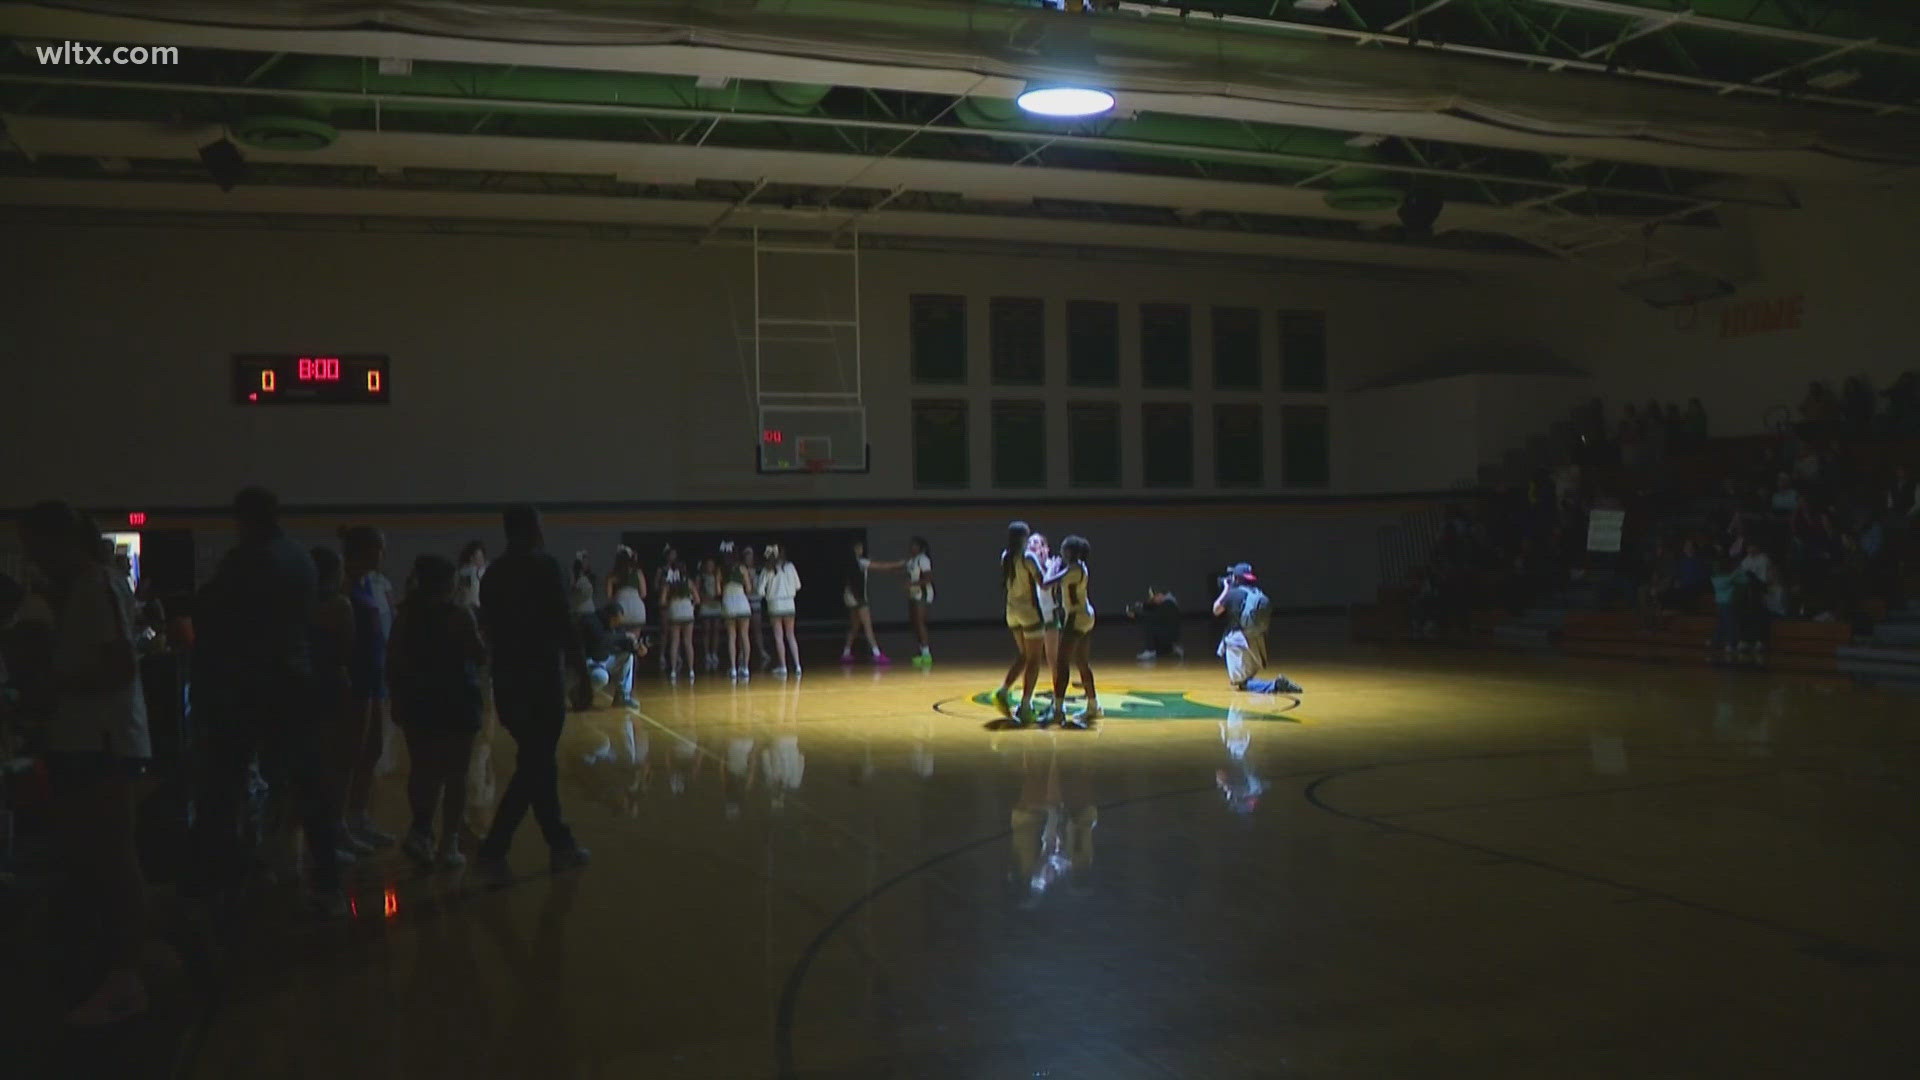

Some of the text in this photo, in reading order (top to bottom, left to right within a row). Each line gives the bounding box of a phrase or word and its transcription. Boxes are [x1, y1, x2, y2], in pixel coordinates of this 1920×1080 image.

[261, 369, 275, 392] 0
[299, 358, 340, 380] 8:00
[367, 369, 381, 392] 0
